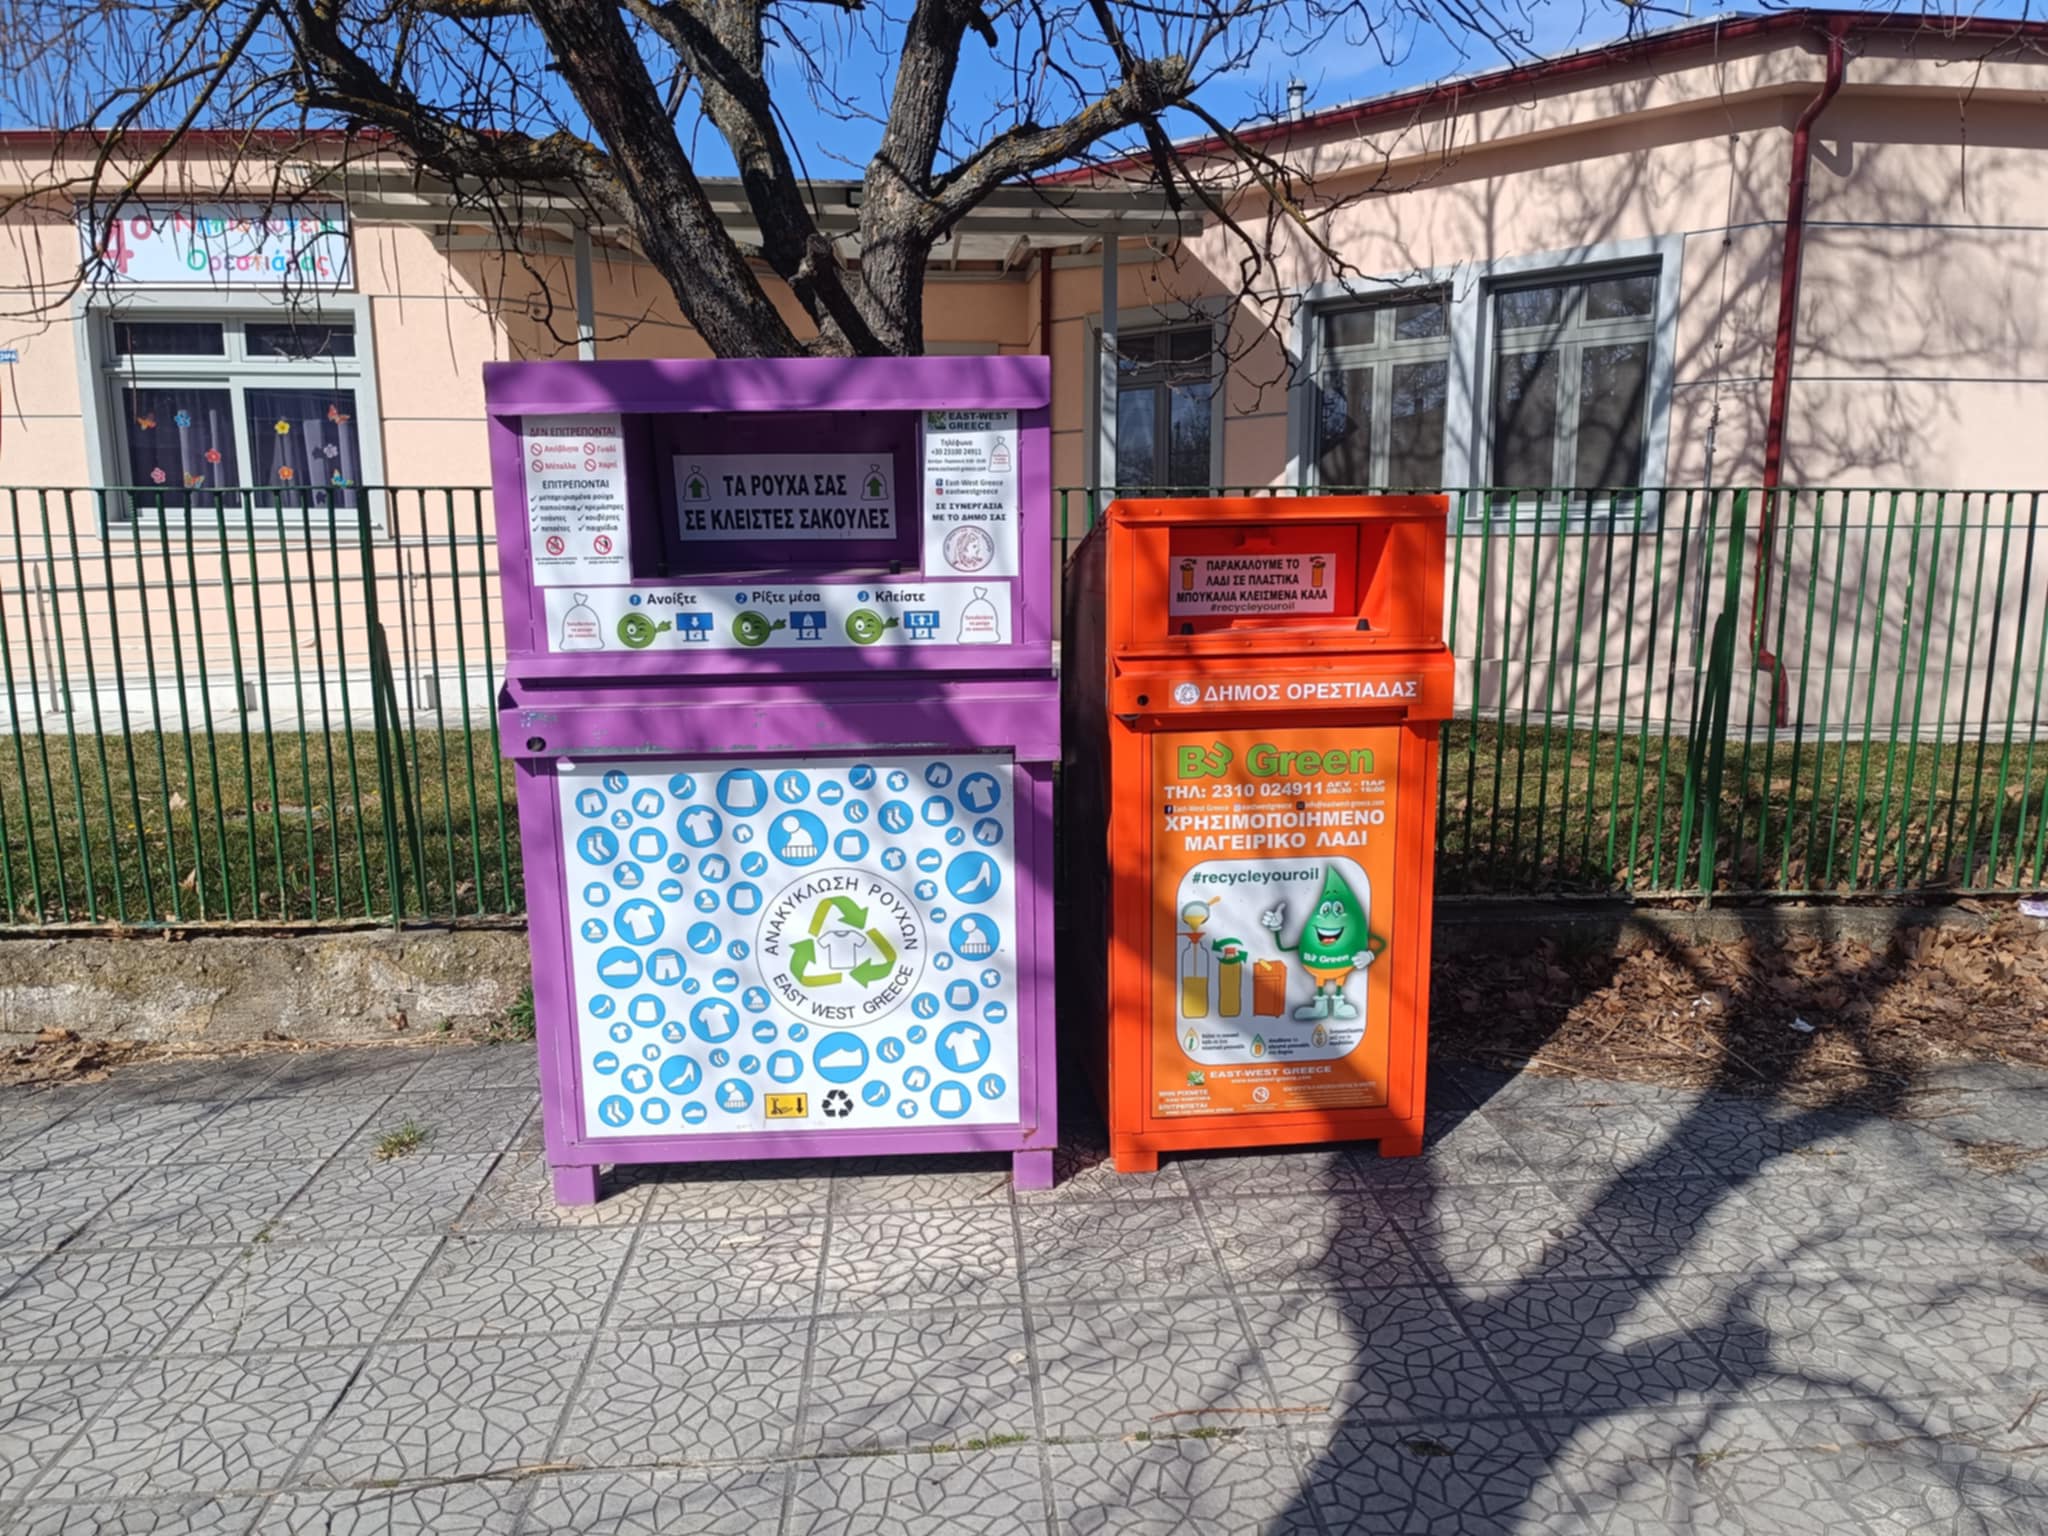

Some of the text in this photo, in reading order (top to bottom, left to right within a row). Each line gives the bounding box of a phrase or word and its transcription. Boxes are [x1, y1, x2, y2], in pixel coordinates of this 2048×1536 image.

[948, 411, 1008, 420] EAST-WEST
[529, 426, 616, 437] ΔΕΝ ΕΠΙΤΡΕΠΟΝΤΑΙ
[948, 422, 992, 431] GREECE
[542, 479, 610, 490] ΕΠΙΤΡΕΠΟΝΤΑΙ
[722, 473, 848, 497] ΤΑ ΡΟΥΧΑ ΣΑΣ
[935, 502, 1004, 510] ΣΕ ΣΥΝΕΡΓΑΣΙΑ
[685, 507, 890, 531] ΣΕ ΚΛΕΙΣΤΕΣ ΣΑΚΟΥΛΕΣ
[990, 513, 1006, 521] ΣΑΣ
[1206, 558, 1300, 572] ΠΑΡΑΚΑΛΟΥΜΕ ΤΟ
[1206, 574, 1300, 587] ΛΑΔΙ ΣΕ ΠΛΑΣΤΙΚΑ
[646, 592, 697, 607] Ανοίξτε
[752, 590, 821, 605] Ρίξτε μέσα
[875, 589, 926, 603] Κλείστε
[1176, 588, 1328, 604] ΜΠΟΥΚΑΛΙΑ ΚΛΕΙΣΜΕΝΑ ΚΑΛΑ
[1210, 602, 1296, 613] #recycleyouroil
[1203, 681, 1418, 702] ΔΗΜΟΣ ΟΡΕΣΤΙΑΔΑΣ
[1246, 743, 1375, 778] Green
[1164, 781, 1323, 800] ΤΗΛ: 2310 024911
[1164, 809, 1386, 832] ΧΡΗΣΙΜΟΠΟΙΗΜΕΝΟ
[1184, 831, 1368, 851] ΜΑΓΕΙΡΙΚΟ ΛΑΔΙ
[1191, 867, 1319, 886] #recycleyouroil
[764, 876, 918, 956] ΑΝΑΚΥΚΛΩΣΗ ΡΟΥΧΩΝ
[772, 964, 914, 1020] EAST WEST GREECE
[1209, 1065, 1332, 1079] EAST-WEST GREECE
